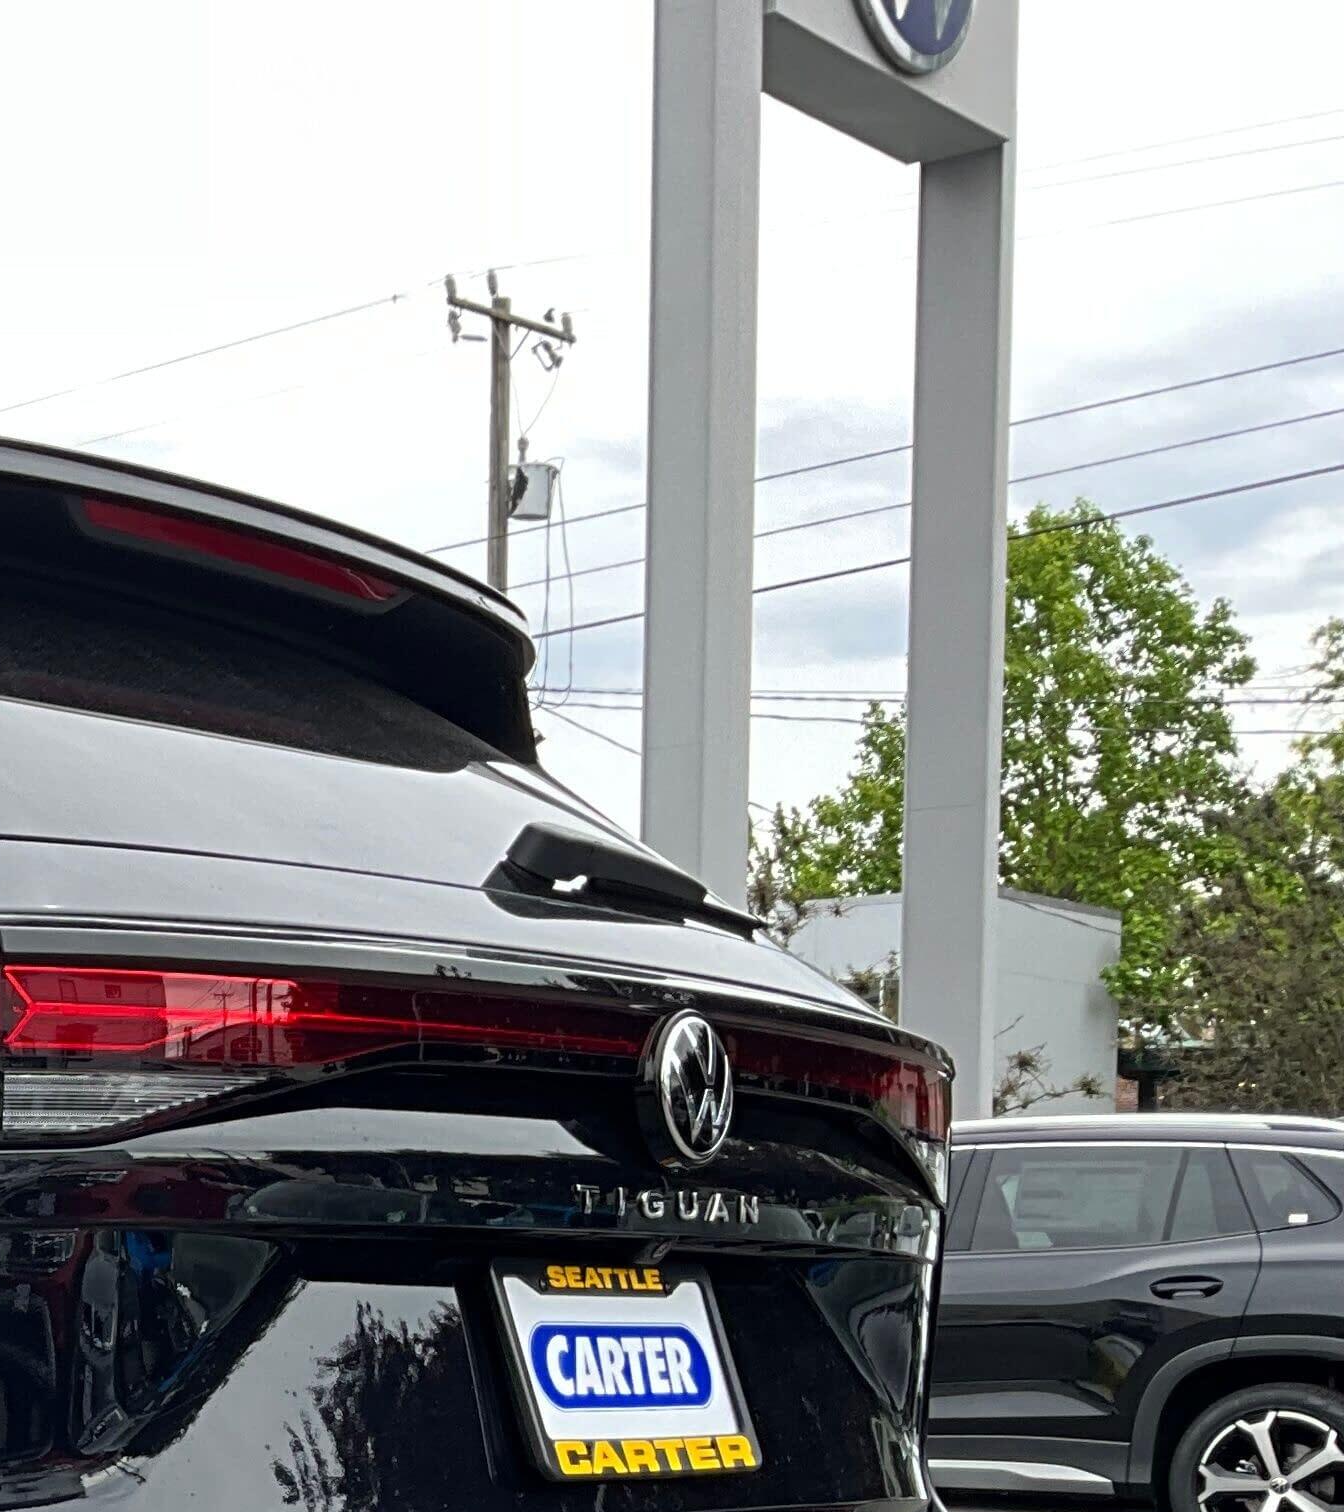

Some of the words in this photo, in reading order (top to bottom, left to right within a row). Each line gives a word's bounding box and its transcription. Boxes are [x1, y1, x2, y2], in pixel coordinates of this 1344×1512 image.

[575, 1184, 760, 1225] TIGUAN
[546, 1264, 664, 1291] SEATTLE
[545, 1334, 699, 1396] CARTER
[554, 1434, 757, 1475] CARTER
